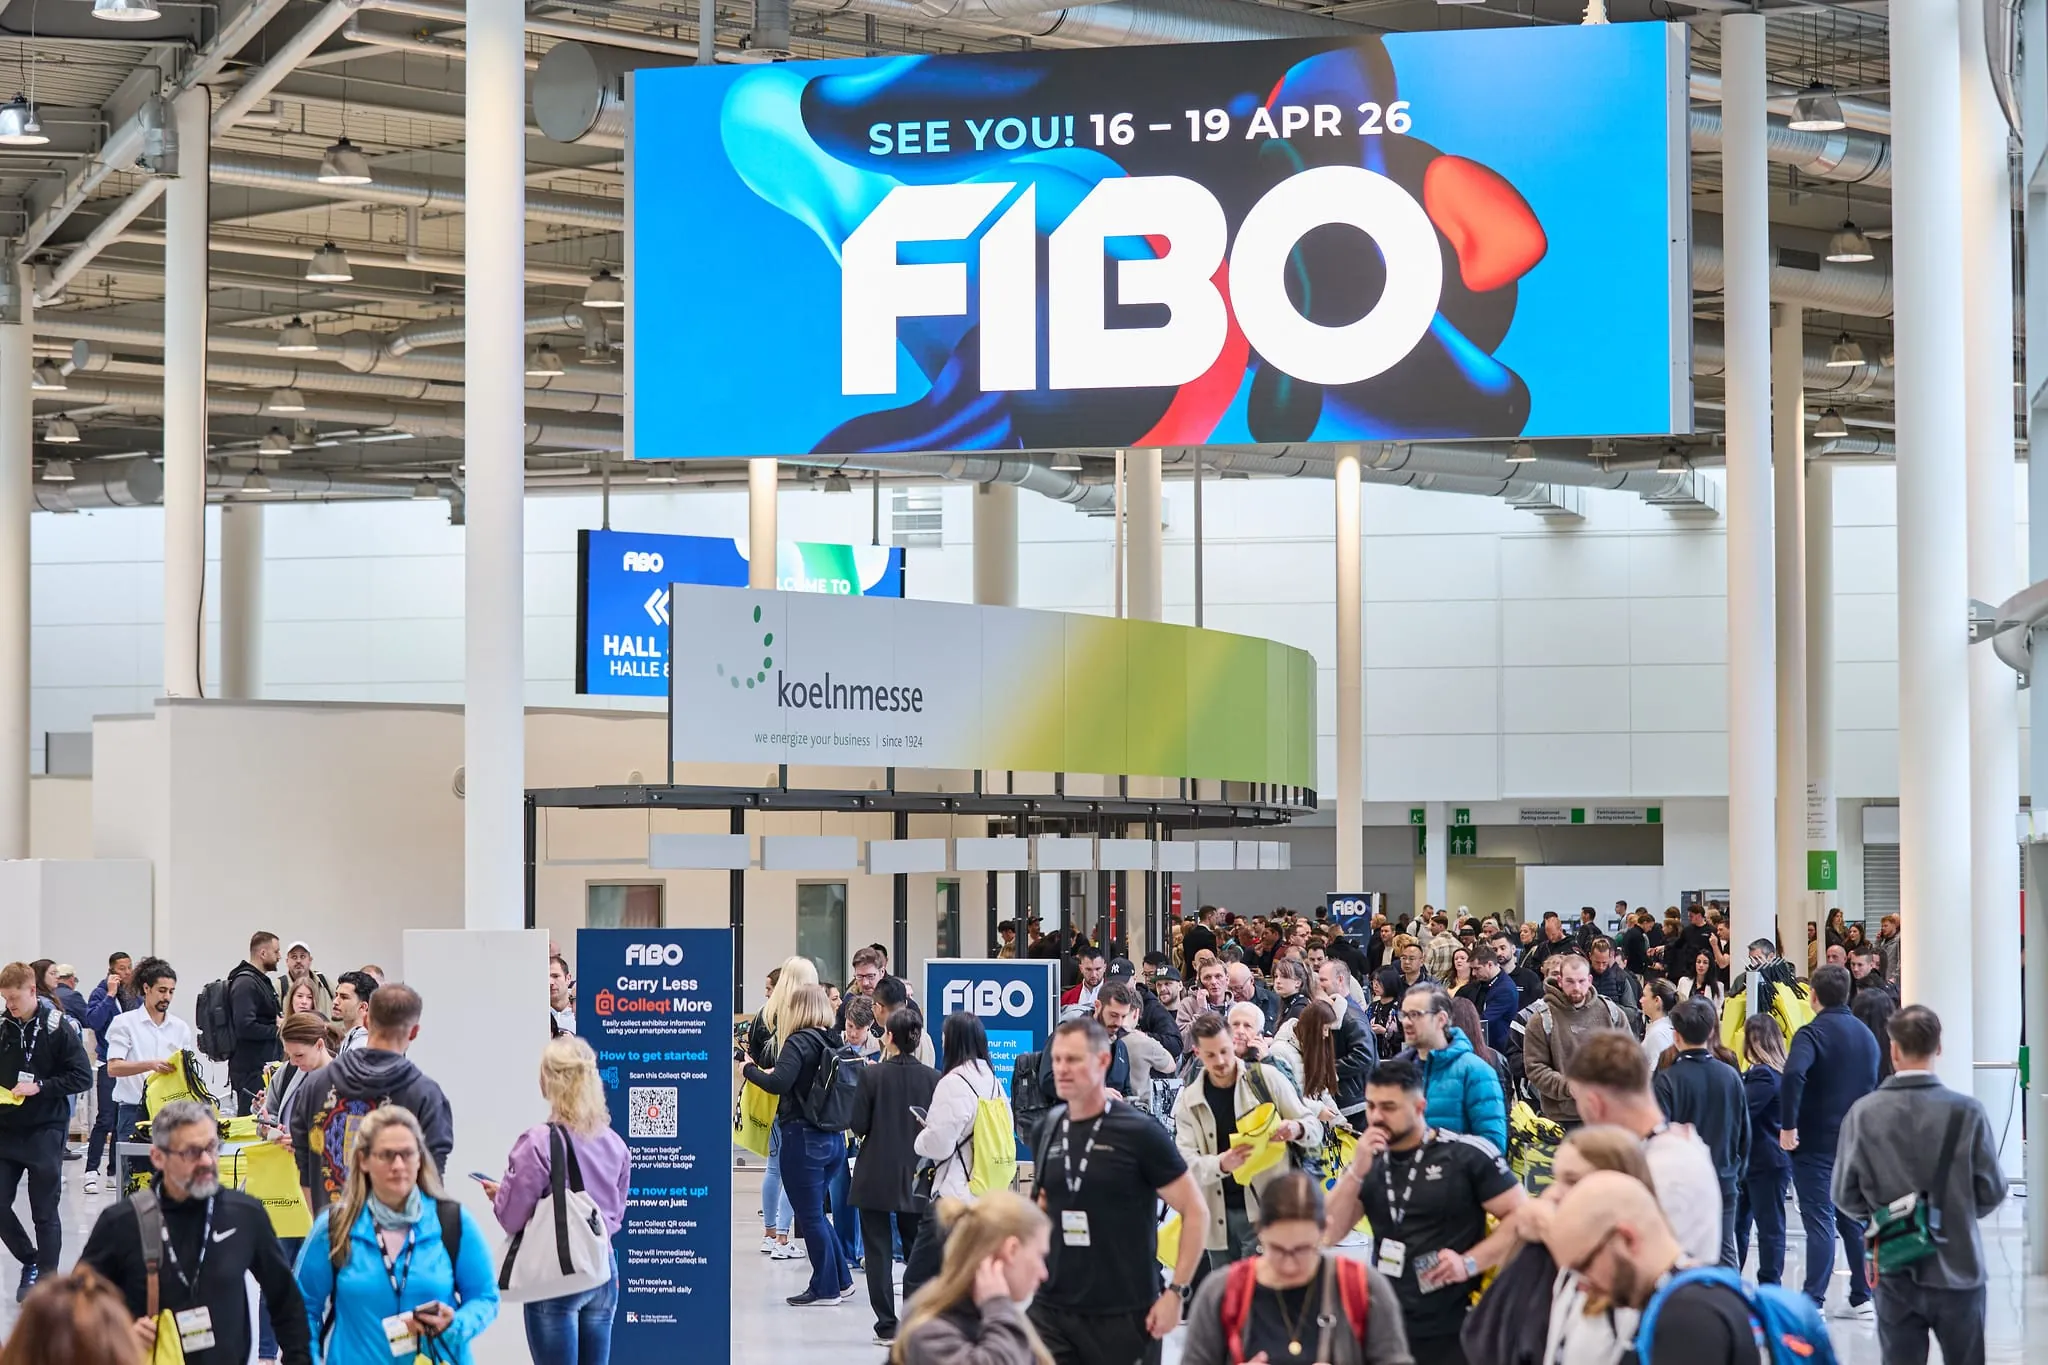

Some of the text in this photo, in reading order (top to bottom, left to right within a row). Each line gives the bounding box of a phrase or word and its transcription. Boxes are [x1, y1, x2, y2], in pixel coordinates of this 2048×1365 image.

[869, 120, 951, 155] SEE
[964, 115, 1075, 152] YOU!
[1090, 113, 1135, 146] 16
[1185, 110, 1230, 142] 19
[1245, 104, 1342, 140] APR
[1358, 101, 1412, 136] 26
[841, 165, 1444, 396] FIBO
[623, 551, 664, 573] FIBO
[777, 577, 851, 594] LCOME TO
[603, 634, 661, 657] HALL
[610, 660, 660, 677] HALLE
[778, 670, 923, 712] koelnmesse
[754, 731, 923, 748] we energize your business since 1924
[1332, 900, 1366, 916] FIBO
[626, 944, 684, 966] FIBO
[616, 976, 698, 993] Carry Less
[617, 998, 712, 1015] Colleqt More
[943, 979, 1034, 1017] FIBO
[602, 1019, 619, 1027] Easily
[640, 1027, 677, 1035] smartphone
[600, 1050, 708, 1062] How to get started:
[990, 1051, 1009, 1059] icket
[658, 1072, 680, 1080] Colleqt
[628, 1186, 708, 1197] re now set up!
[670, 1198, 687, 1208] just:
[628, 1249, 643, 1257] They
[656, 1249, 694, 1257] immediately
[677, 1286, 692, 1294] daily
